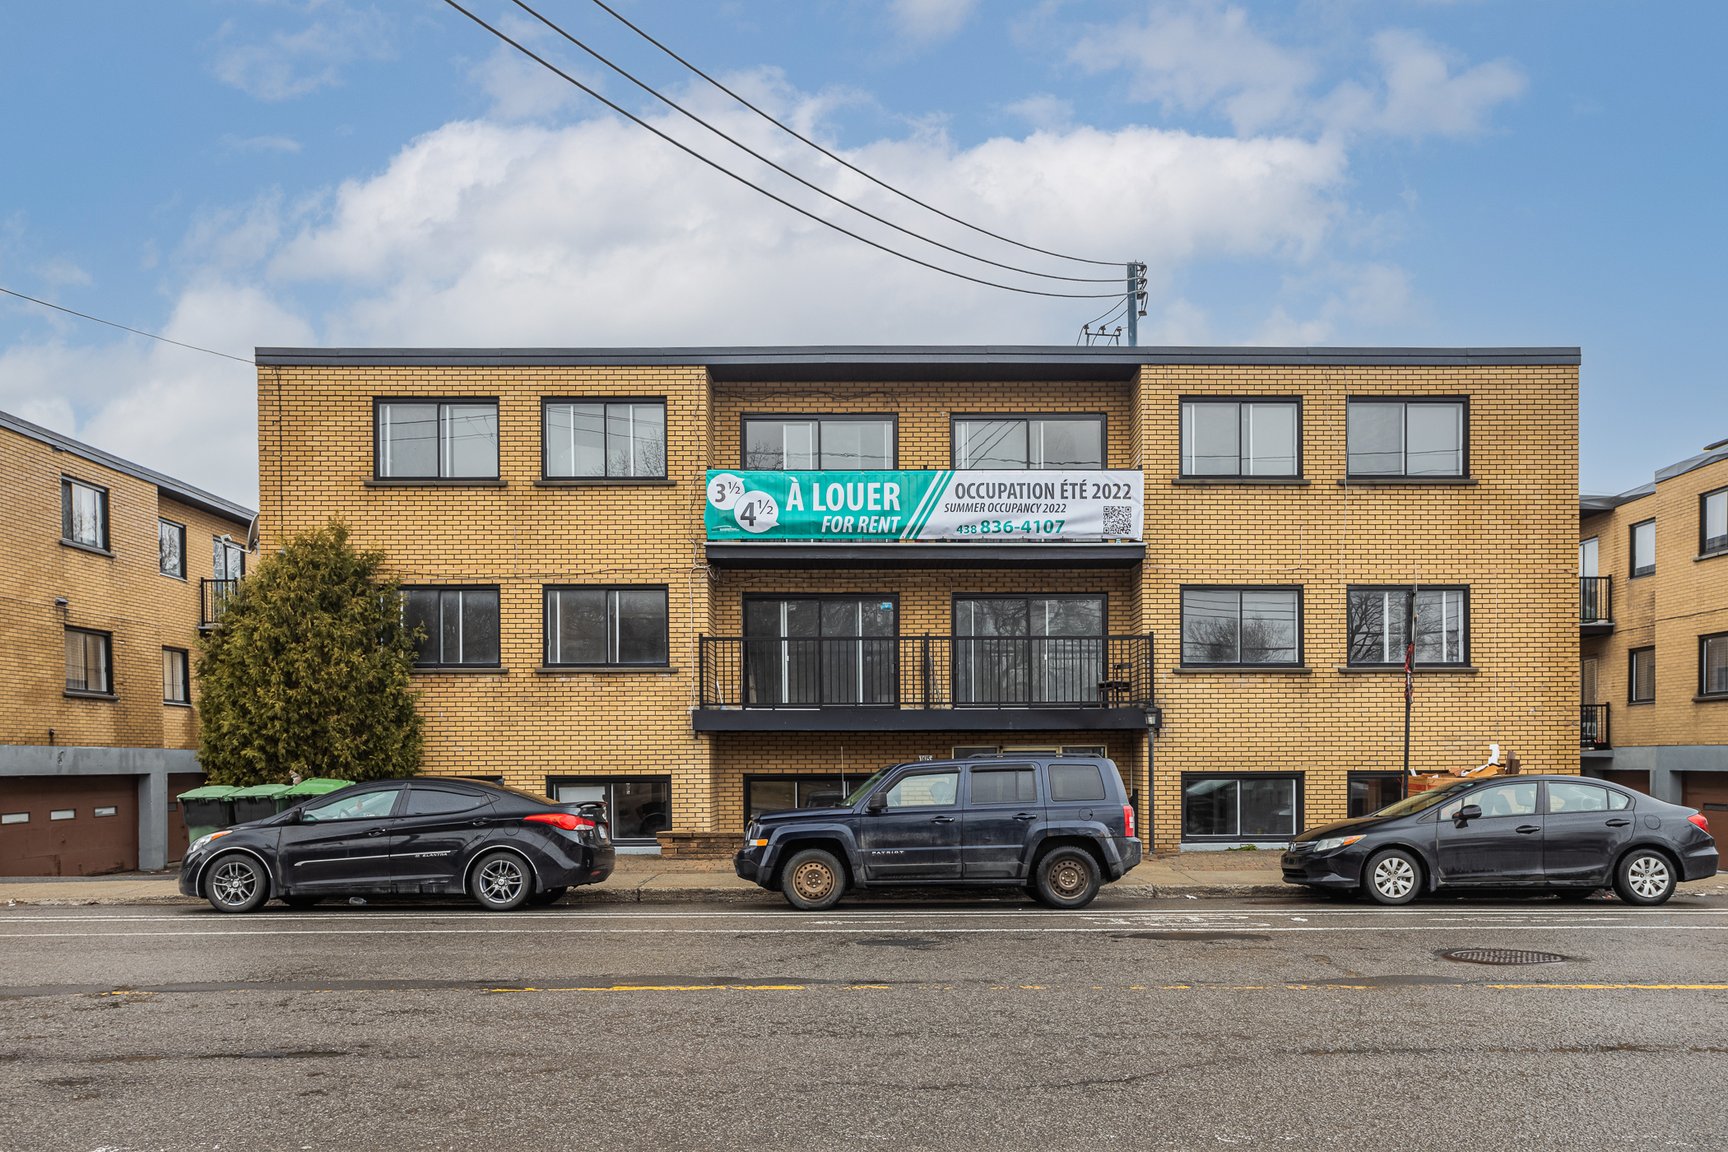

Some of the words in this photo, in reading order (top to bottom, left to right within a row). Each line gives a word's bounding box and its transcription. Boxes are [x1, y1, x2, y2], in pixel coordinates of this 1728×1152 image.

[785, 476, 804, 511] À
[812, 482, 900, 511] LOUER
[955, 482, 1055, 500] OCCUPATION
[1060, 479, 1087, 500] ÉTÉ
[1091, 483, 1132, 500] 2022
[944, 502, 985, 513] SUMMER
[987, 502, 1042, 514] OCCUPANCY
[1042, 503, 1067, 513] 2022
[821, 515, 853, 533] FOR
[857, 516, 901, 533] RENT
[956, 524, 977, 534] 438
[980, 519, 1066, 534] 836-4107
